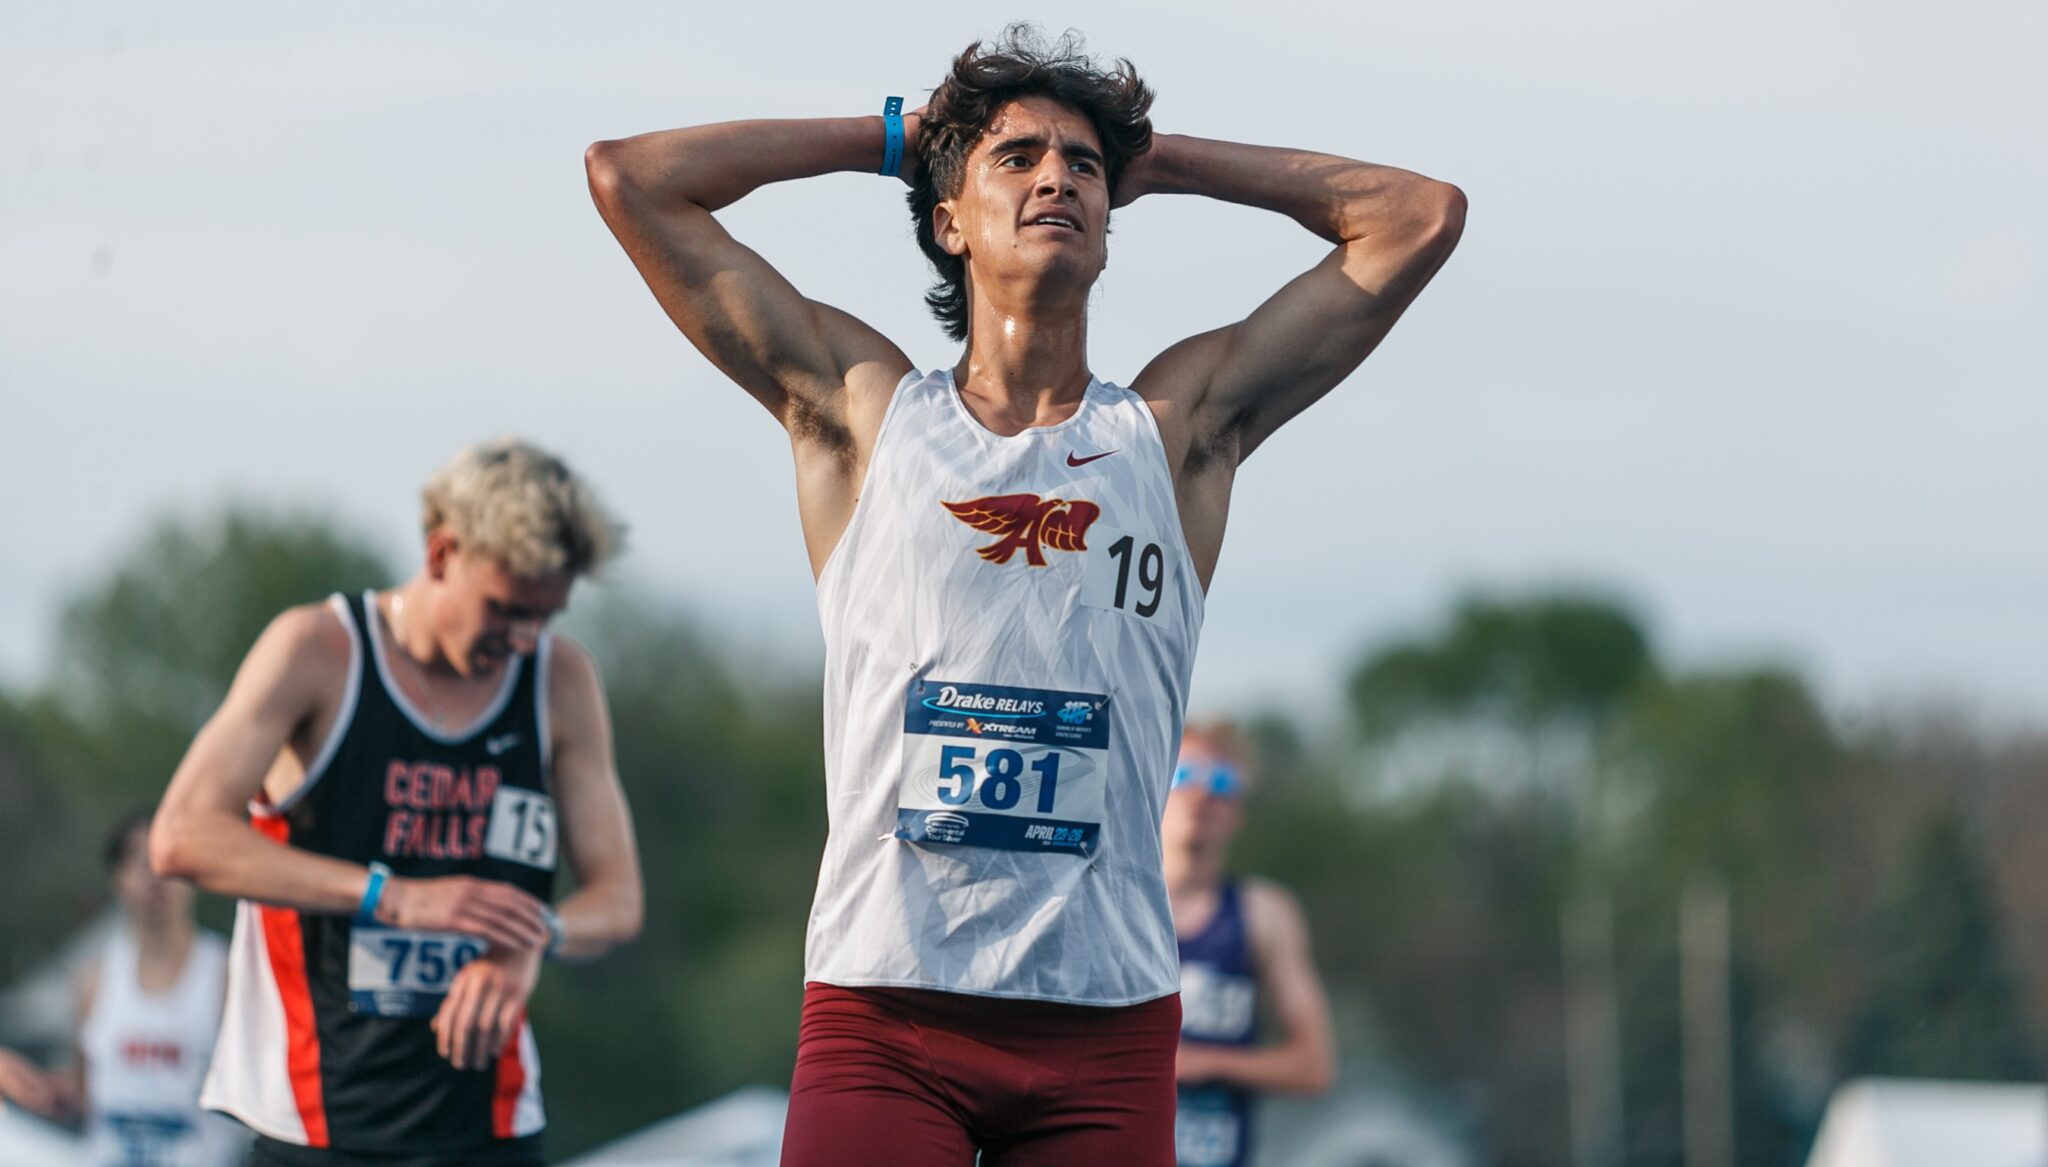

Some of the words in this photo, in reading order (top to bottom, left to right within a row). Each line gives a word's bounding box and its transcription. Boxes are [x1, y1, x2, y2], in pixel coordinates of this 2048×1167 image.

[1108, 535, 1165, 618] 19
[937, 686, 995, 709] Drake
[995, 698, 1043, 714] RELAYS
[982, 722, 1037, 735] XTREAM
[386, 759, 500, 810] CEDAR
[937, 745, 1060, 814] 581
[385, 810, 486, 859] FALLS
[512, 800, 547, 859] 15
[1025, 824, 1055, 841] APRIL
